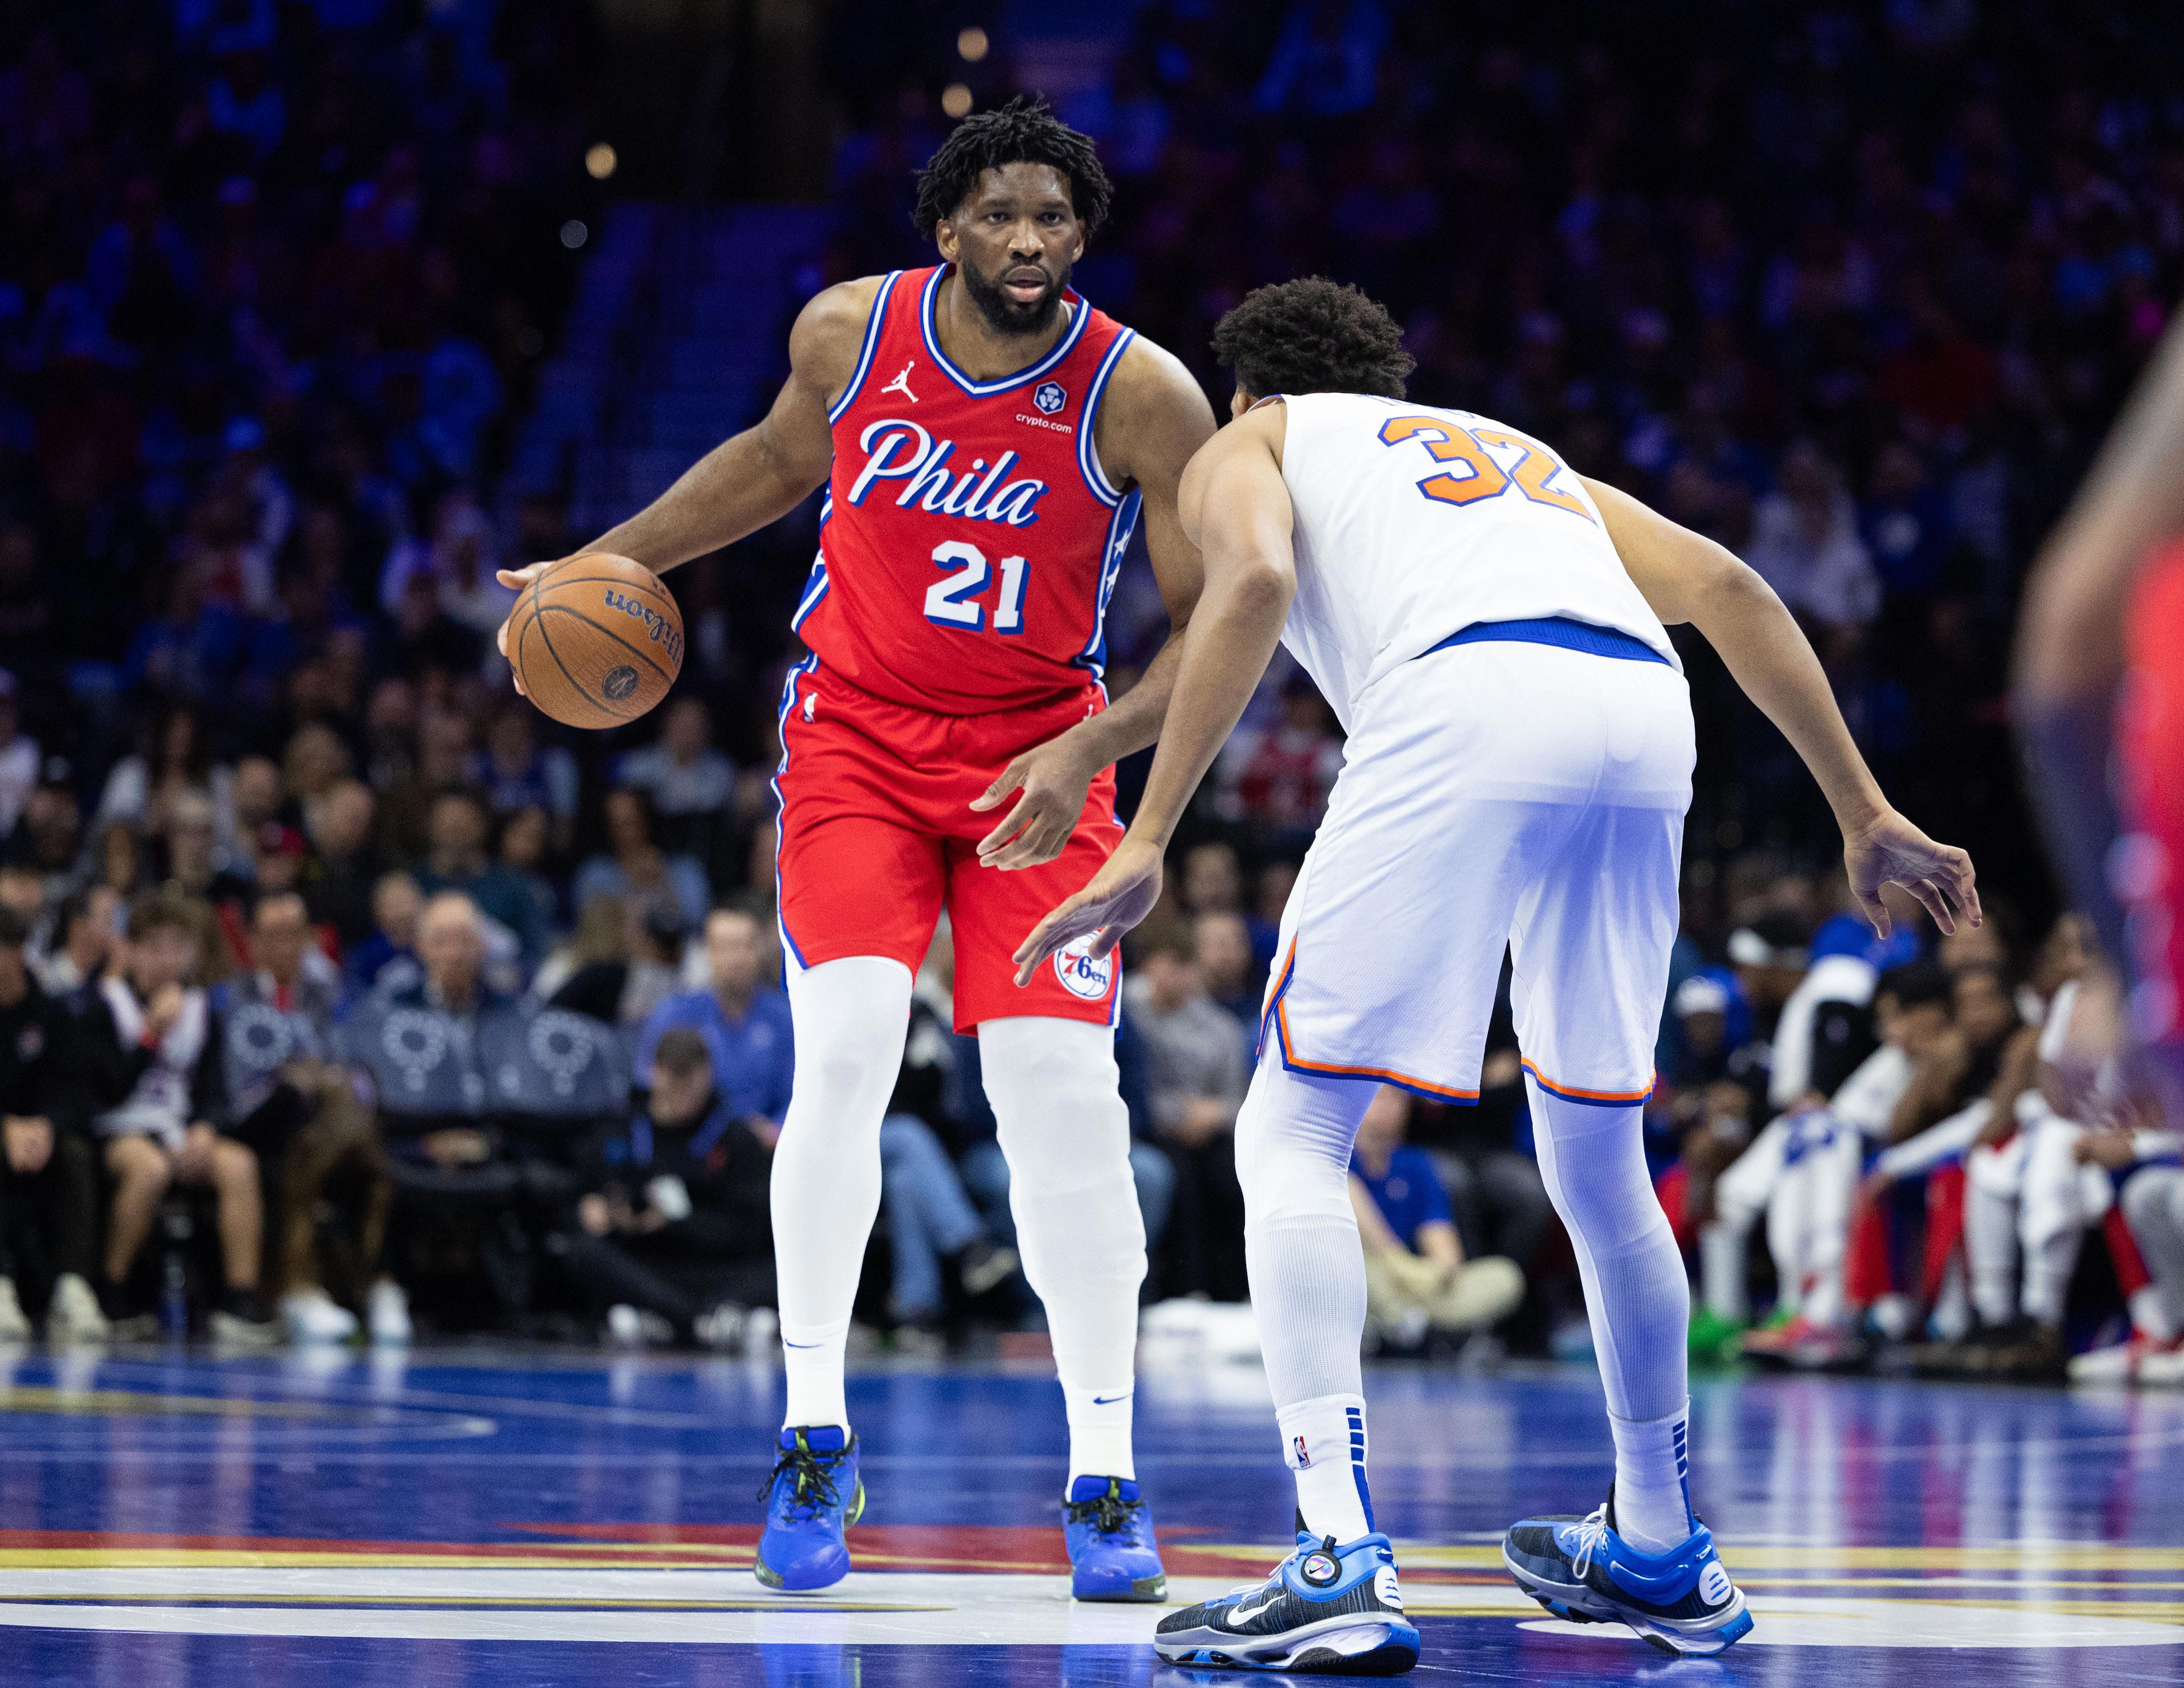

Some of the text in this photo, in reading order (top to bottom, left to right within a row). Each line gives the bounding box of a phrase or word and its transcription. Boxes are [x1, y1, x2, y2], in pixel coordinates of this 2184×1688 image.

[1016, 414, 1072, 434] crypto.com
[1377, 415, 1599, 528] 32
[848, 418, 1050, 528] Phila
[604, 588, 684, 670] Wilson
[924, 540, 1031, 635] 21
